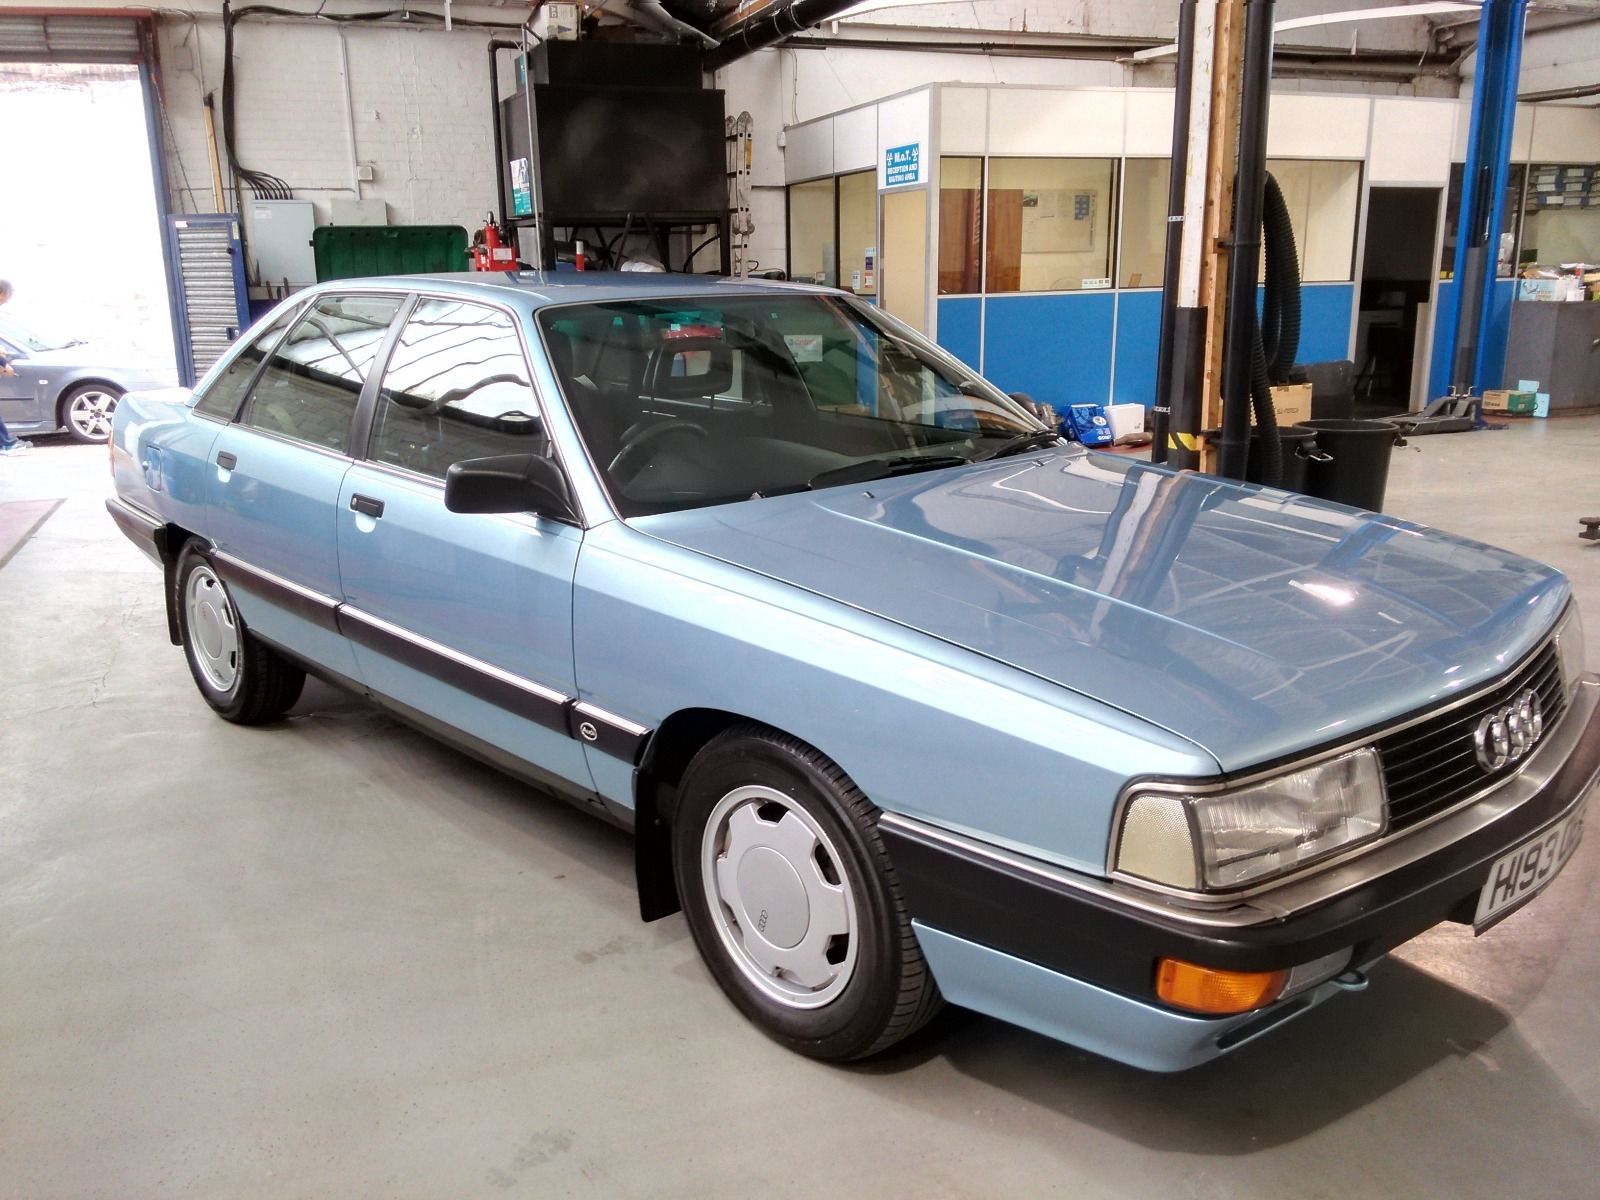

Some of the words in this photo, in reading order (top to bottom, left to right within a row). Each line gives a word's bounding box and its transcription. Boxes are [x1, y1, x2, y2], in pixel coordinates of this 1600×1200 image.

[888, 165, 908, 174] RECEPTION
[909, 163, 917, 172] AND
[888, 174, 904, 183] WAITING
[905, 172, 916, 180] AREA
